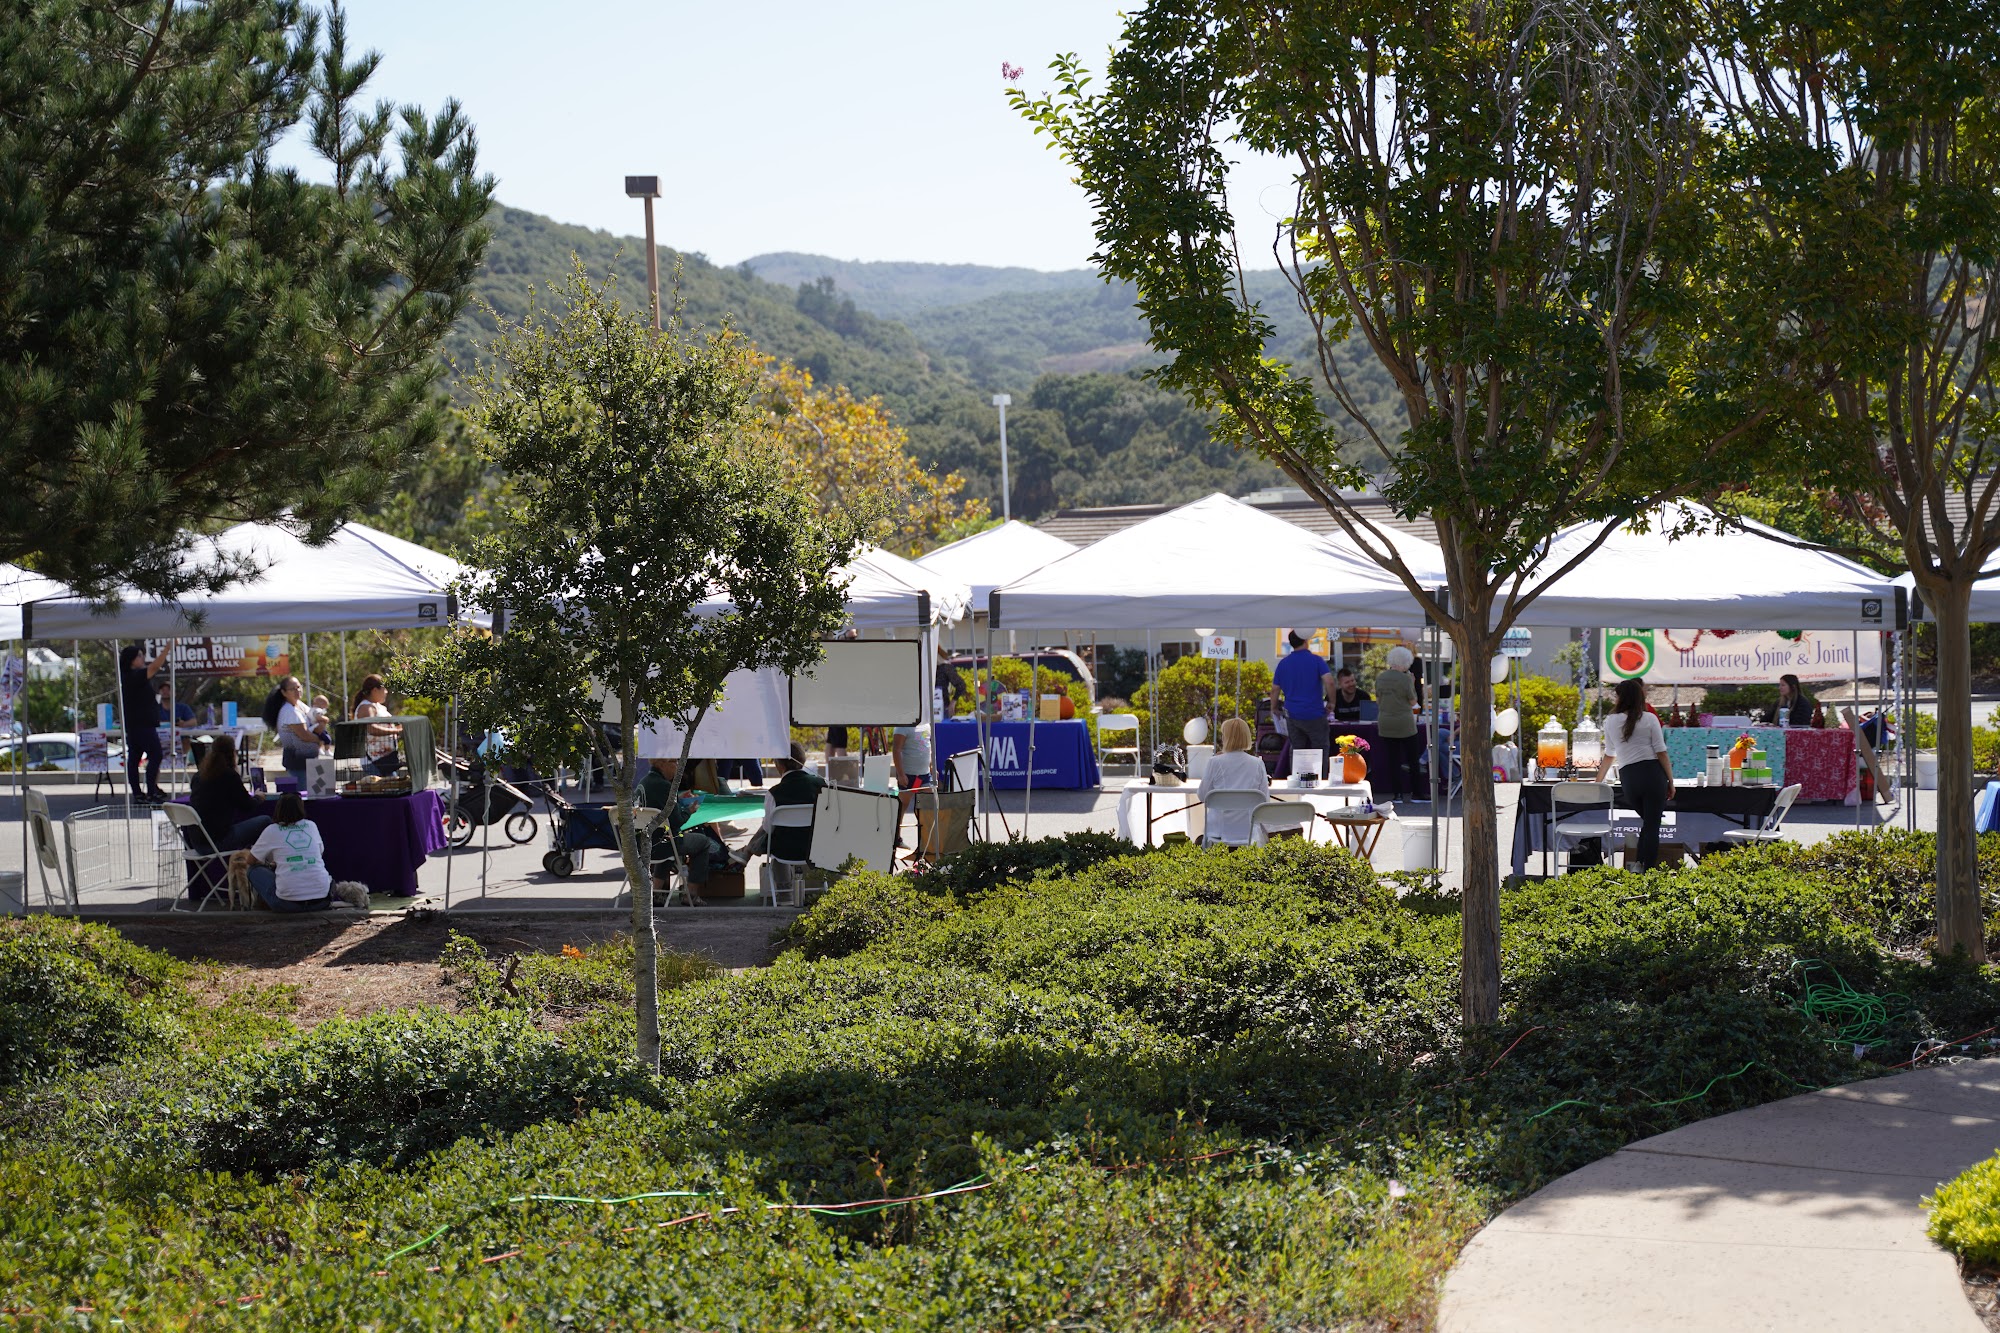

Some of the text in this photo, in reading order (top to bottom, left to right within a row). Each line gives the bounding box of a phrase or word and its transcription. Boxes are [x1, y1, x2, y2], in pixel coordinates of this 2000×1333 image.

[1511, 630, 1528, 639] AM
[1608, 628, 1629, 636] Bell
[1502, 639, 1531, 647] STRONG
[211, 644, 246, 660] Run
[1680, 640, 1851, 671] Monterey Spine & Joint
